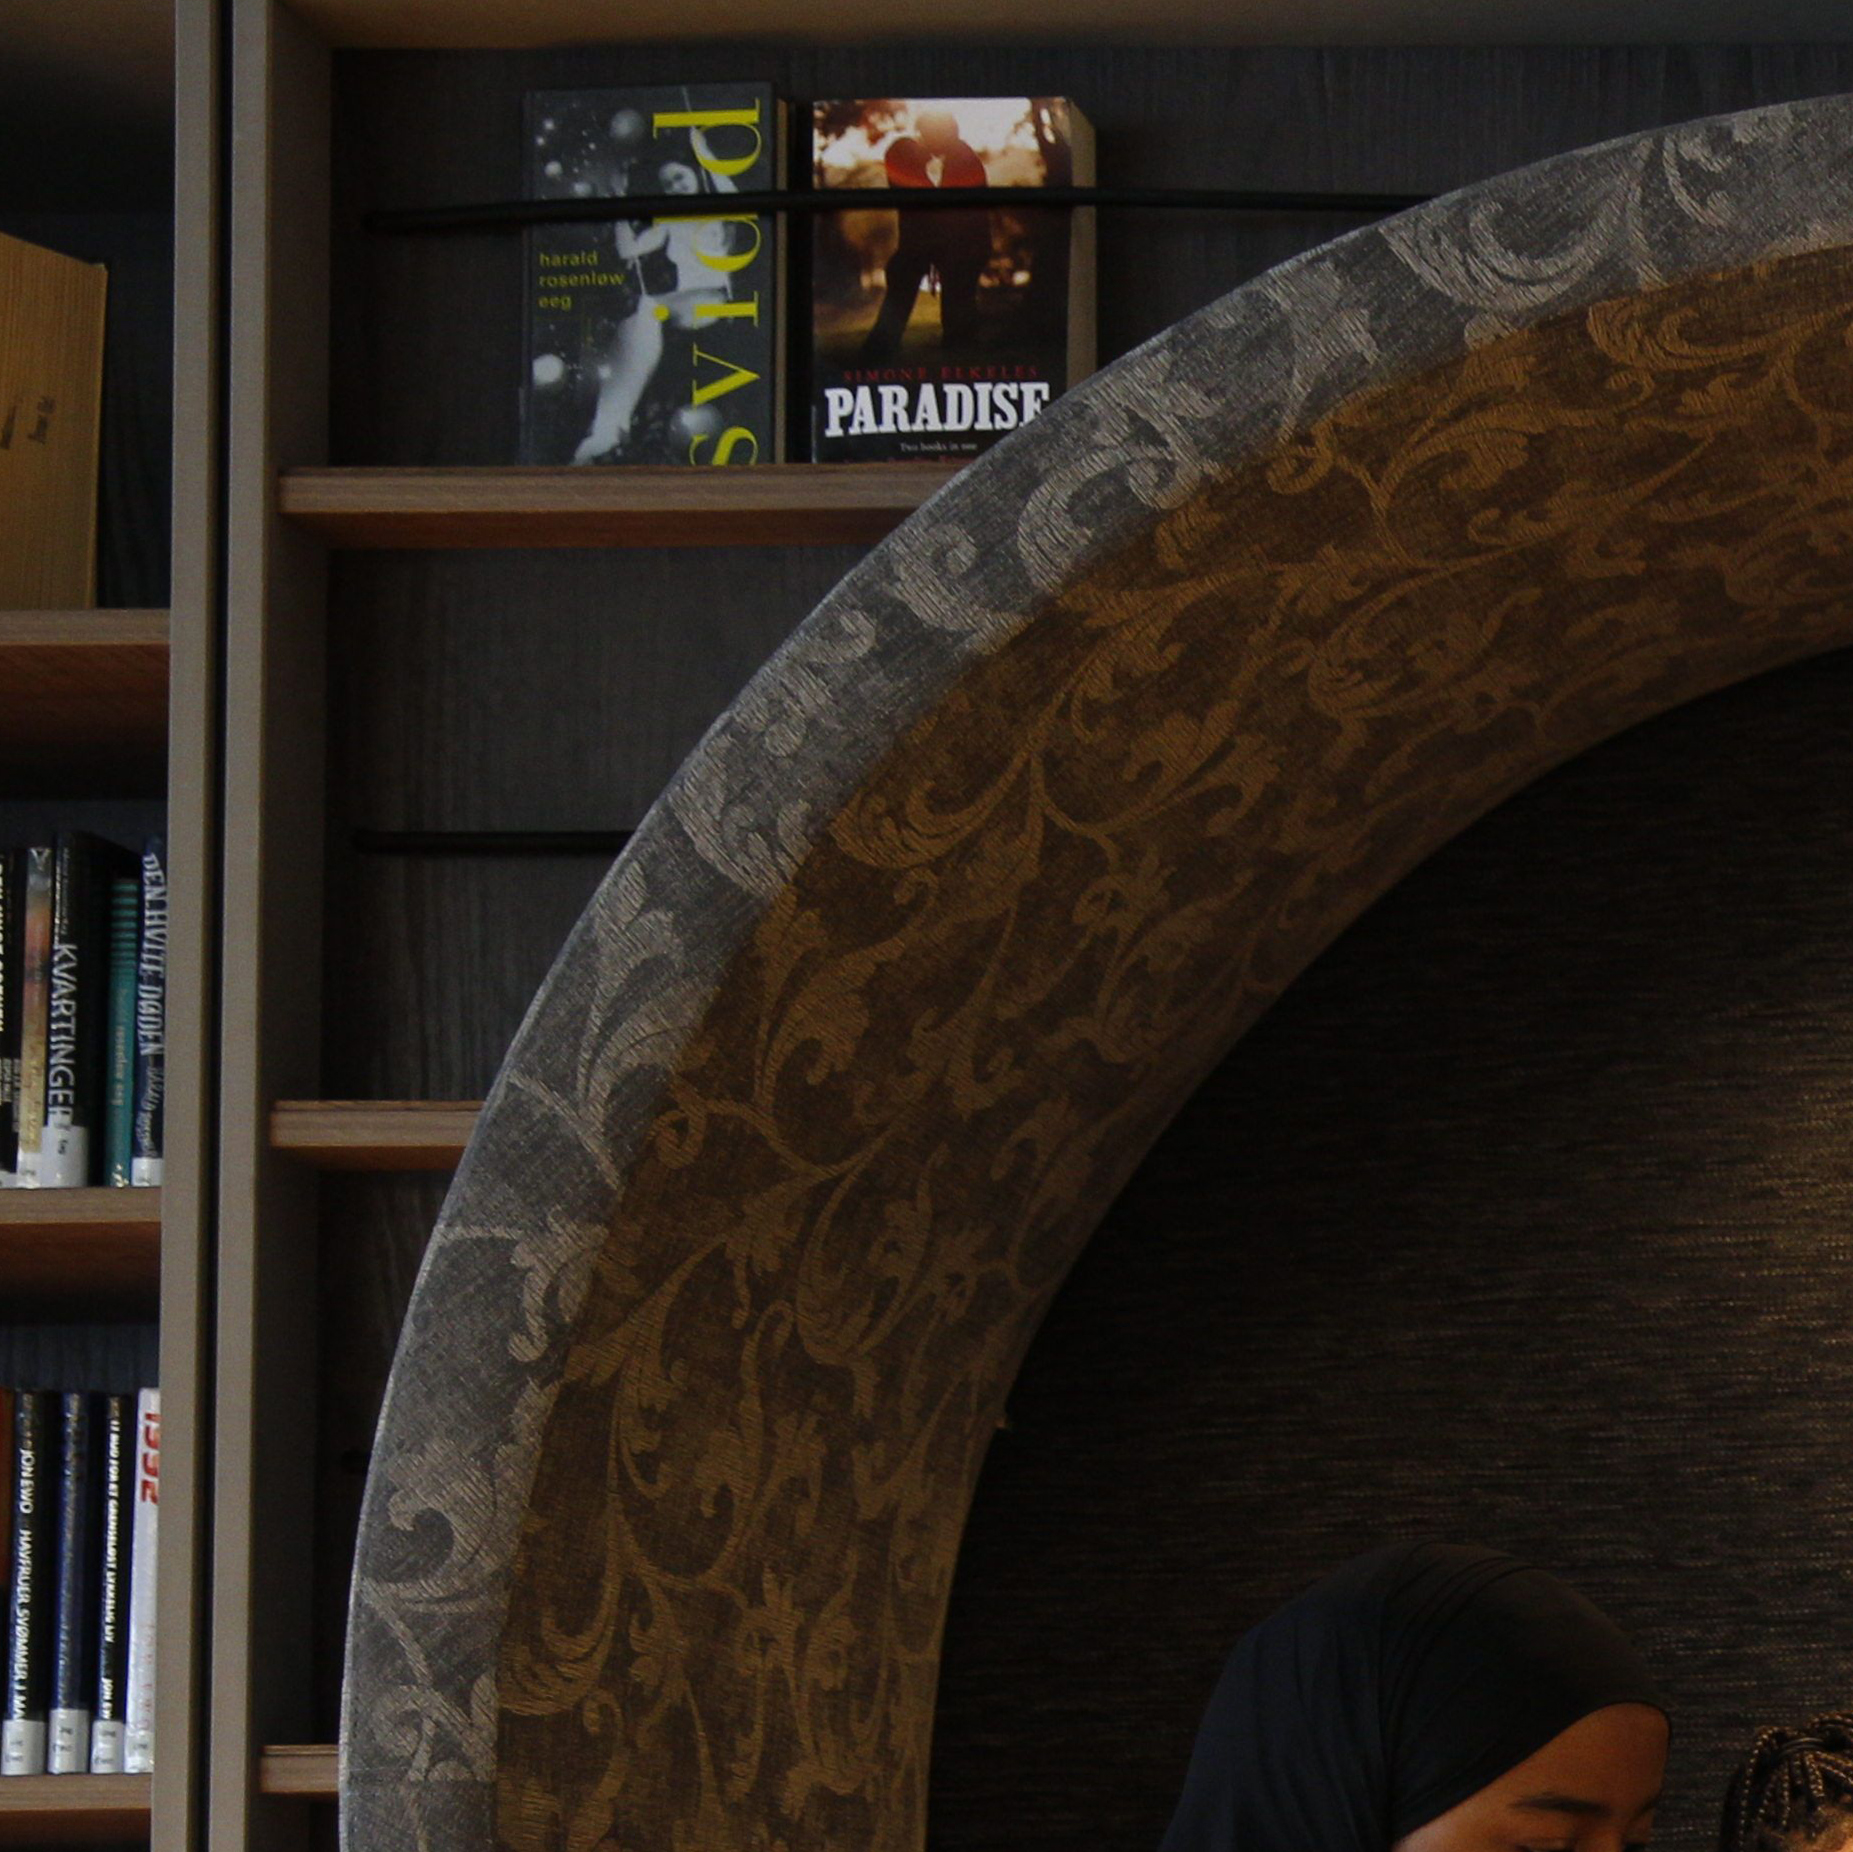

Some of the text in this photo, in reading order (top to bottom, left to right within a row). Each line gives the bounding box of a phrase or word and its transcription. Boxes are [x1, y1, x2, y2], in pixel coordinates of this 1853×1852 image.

[18, 1449, 34, 1514] JON EWO
[13, 1530, 33, 1680] HAVFRUER SVØMMER
